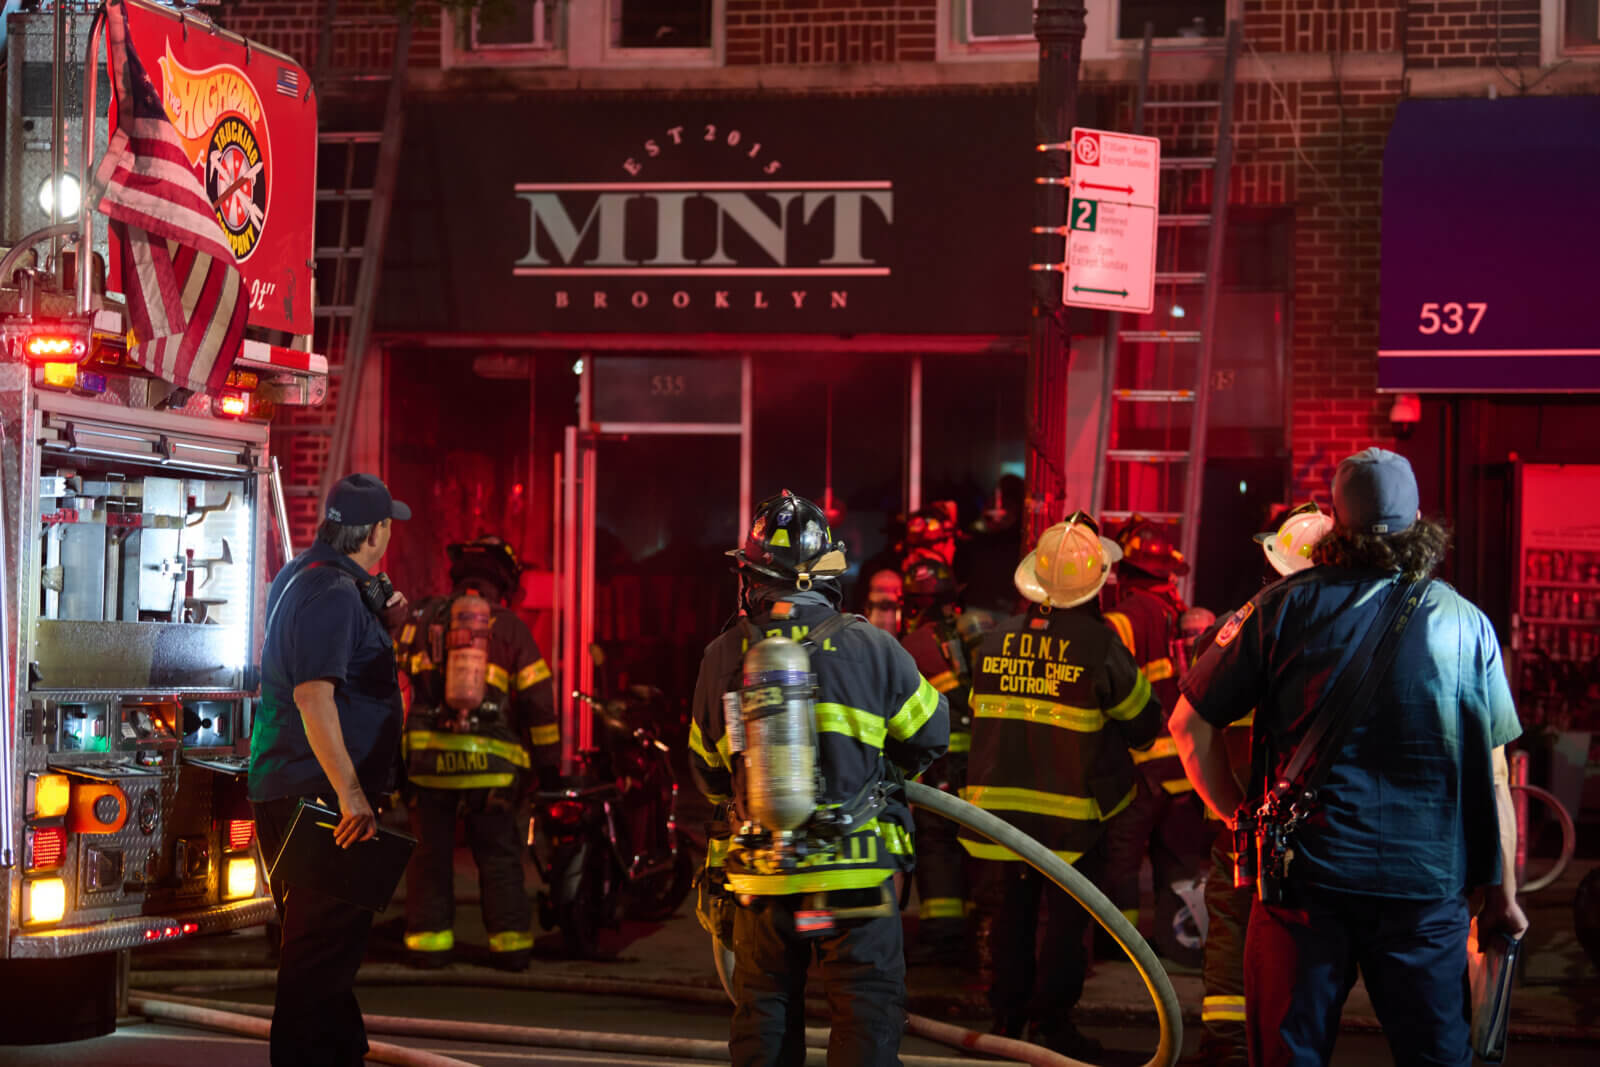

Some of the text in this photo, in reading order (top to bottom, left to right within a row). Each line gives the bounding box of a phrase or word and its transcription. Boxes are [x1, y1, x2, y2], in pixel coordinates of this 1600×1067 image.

[174, 73, 260, 138] HIGHWAY
[214, 121, 259, 166] TRUCKING
[622, 124, 781, 176] EST 2015
[515, 191, 893, 266] MINT
[1076, 201, 1092, 229] 2
[555, 291, 848, 308] BROOKLYN
[1419, 302, 1488, 335] 537
[651, 375, 688, 396] 535
[982, 656, 1084, 683] DEPUTY CHIEF
[1000, 675, 1060, 697] CUTRONE
